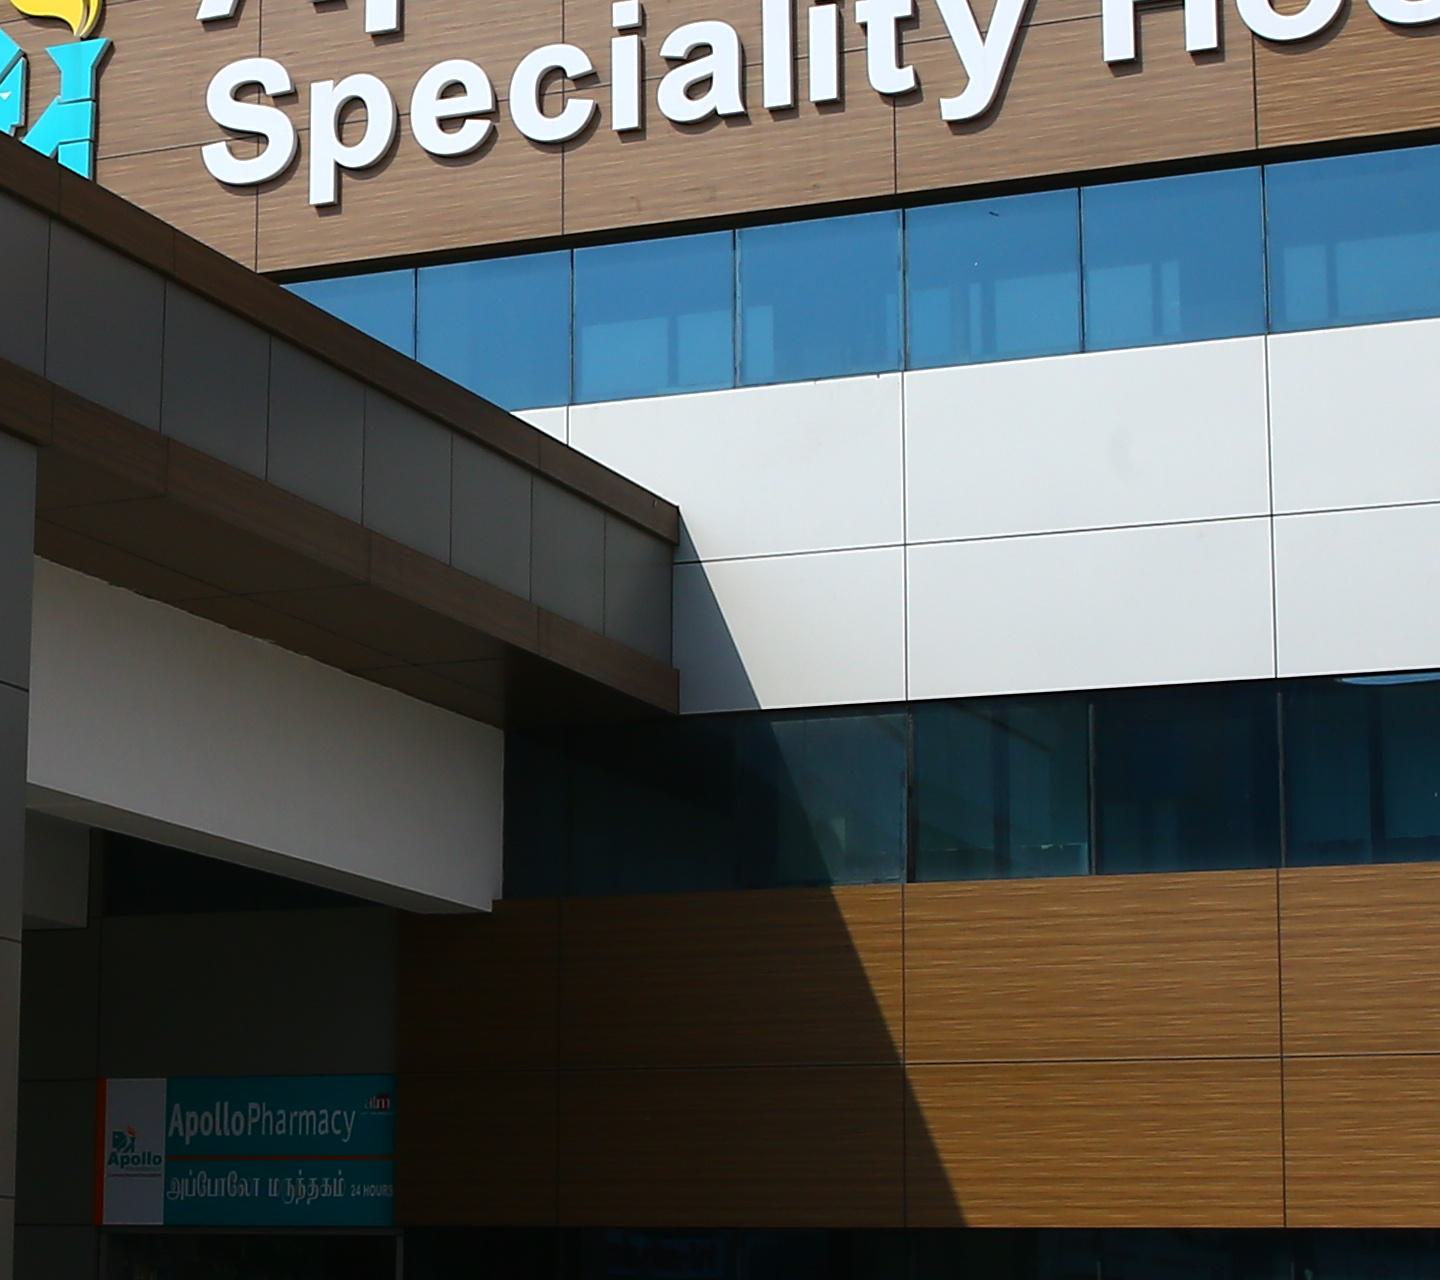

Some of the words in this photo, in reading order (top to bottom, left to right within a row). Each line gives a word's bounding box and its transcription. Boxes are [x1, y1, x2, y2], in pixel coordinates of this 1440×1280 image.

[108, 1151, 163, 1169] Apollo
[166, 1170, 260, 1201] அப்போலோ
[268, 1169, 345, 1205] மருந்தகம்
[350, 1183, 361, 1197] 24
[363, 1183, 394, 1197] HOURS
